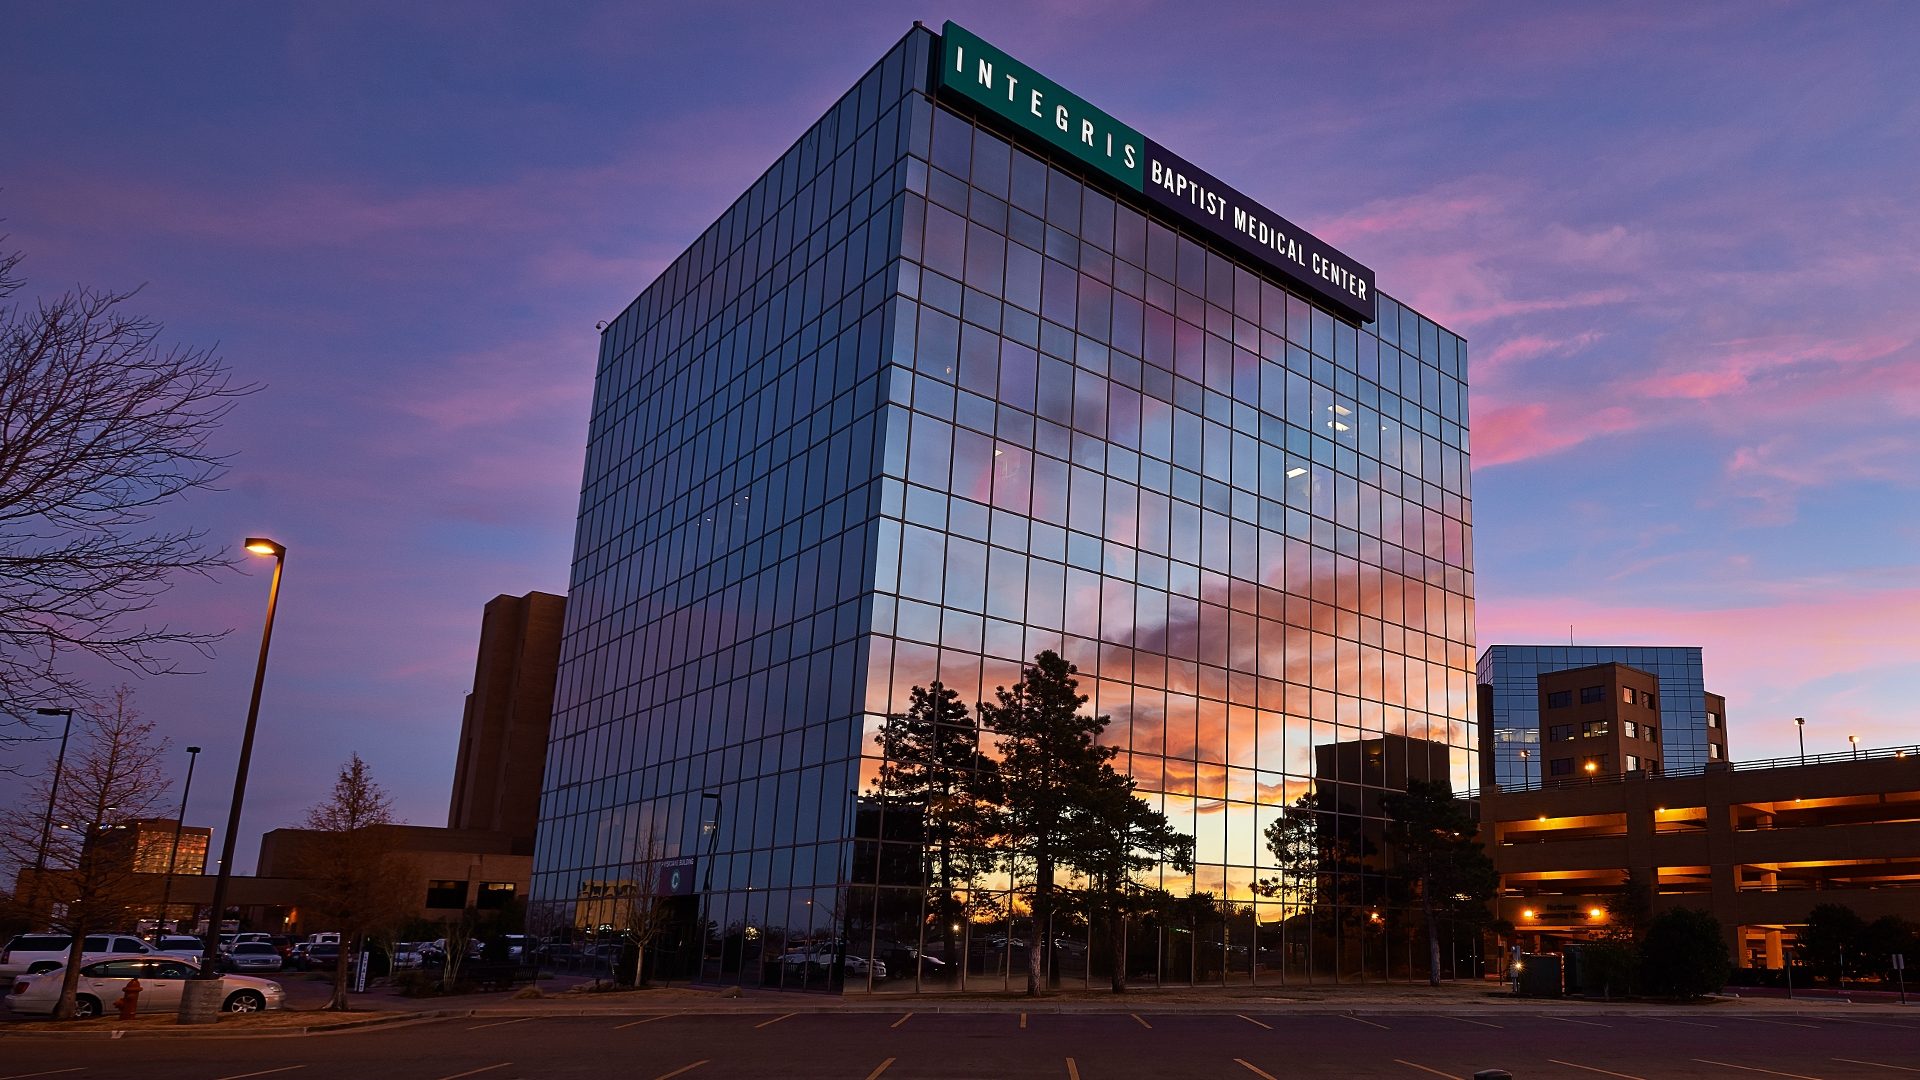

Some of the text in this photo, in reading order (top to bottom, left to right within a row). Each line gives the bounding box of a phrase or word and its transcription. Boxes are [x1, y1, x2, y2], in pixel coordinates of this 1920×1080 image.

[955, 46, 1136, 169] INTEGRIS
[1151, 158, 1367, 301] BAPTIST MEDICAL CENTER
[671, 872, 679, 889] C
